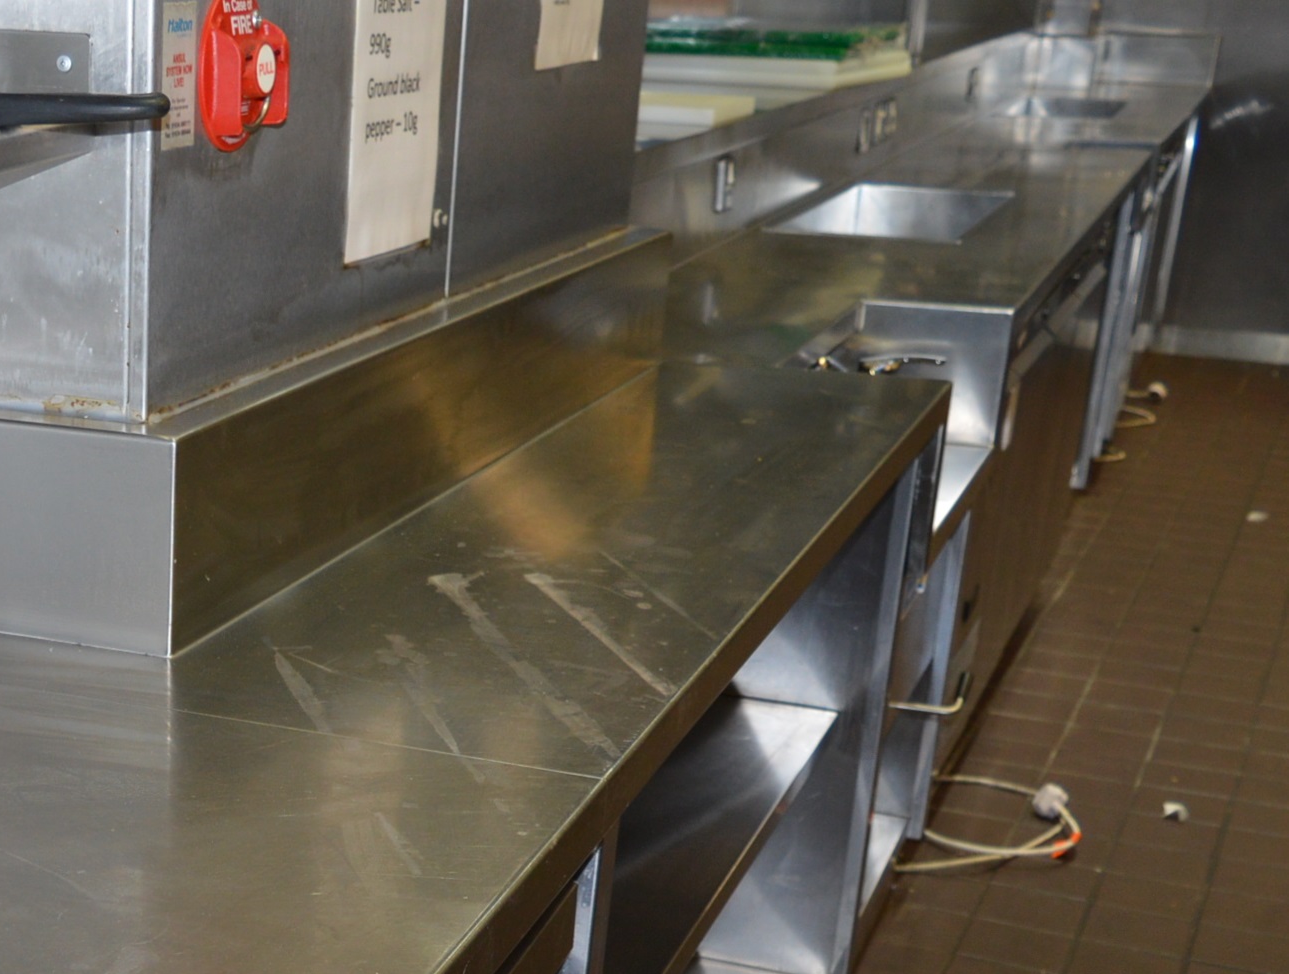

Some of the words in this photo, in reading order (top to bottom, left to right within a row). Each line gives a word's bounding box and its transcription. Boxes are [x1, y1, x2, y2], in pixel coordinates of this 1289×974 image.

[223, 0, 231, 13] In
[167, 18, 193, 34] Halton
[230, 15, 253, 36] FIRE
[369, 32, 392, 59] 990g
[259, 63, 274, 75] PULL
[367, 74, 399, 99] Ground
[400, 72, 421, 93] black
[365, 118, 394, 143] pepper
[403, 111, 418, 136] 10g
